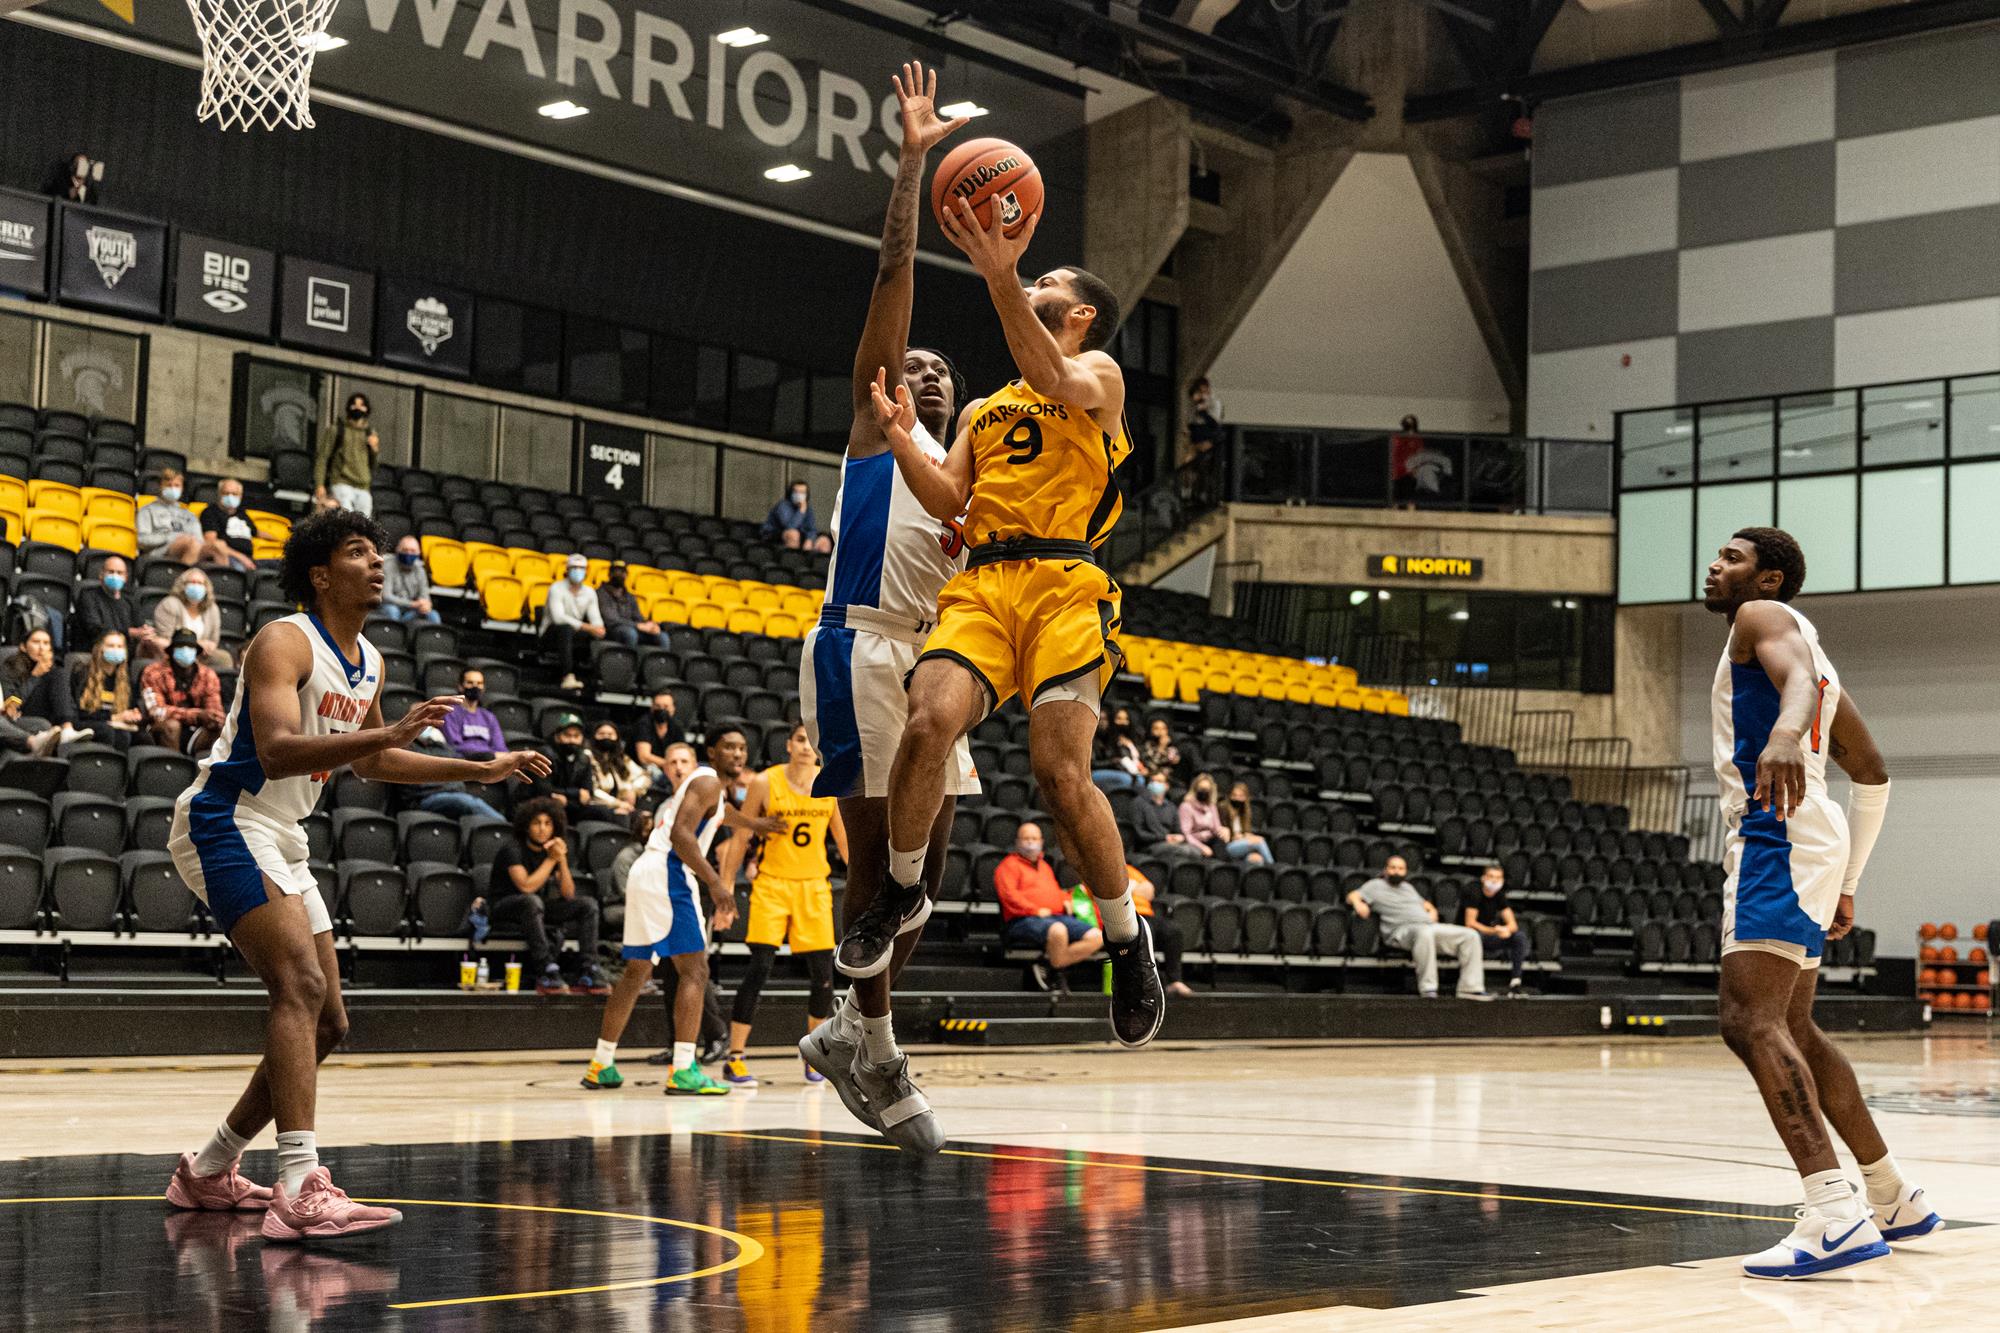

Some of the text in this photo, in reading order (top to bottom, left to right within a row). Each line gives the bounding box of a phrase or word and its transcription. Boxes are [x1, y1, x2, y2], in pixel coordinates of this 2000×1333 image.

[952, 156, 1022, 202] Wilson
[0, 219, 35, 241] REY
[85, 229, 137, 268] YOUTH
[203, 250, 250, 282] BIO
[203, 273, 249, 294] STEEL
[1003, 416, 1043, 465] 9
[590, 443, 641, 467] SECTION
[604, 463, 625, 491] 4
[1406, 558, 1472, 576] NORTH
[792, 822, 812, 847] 6
